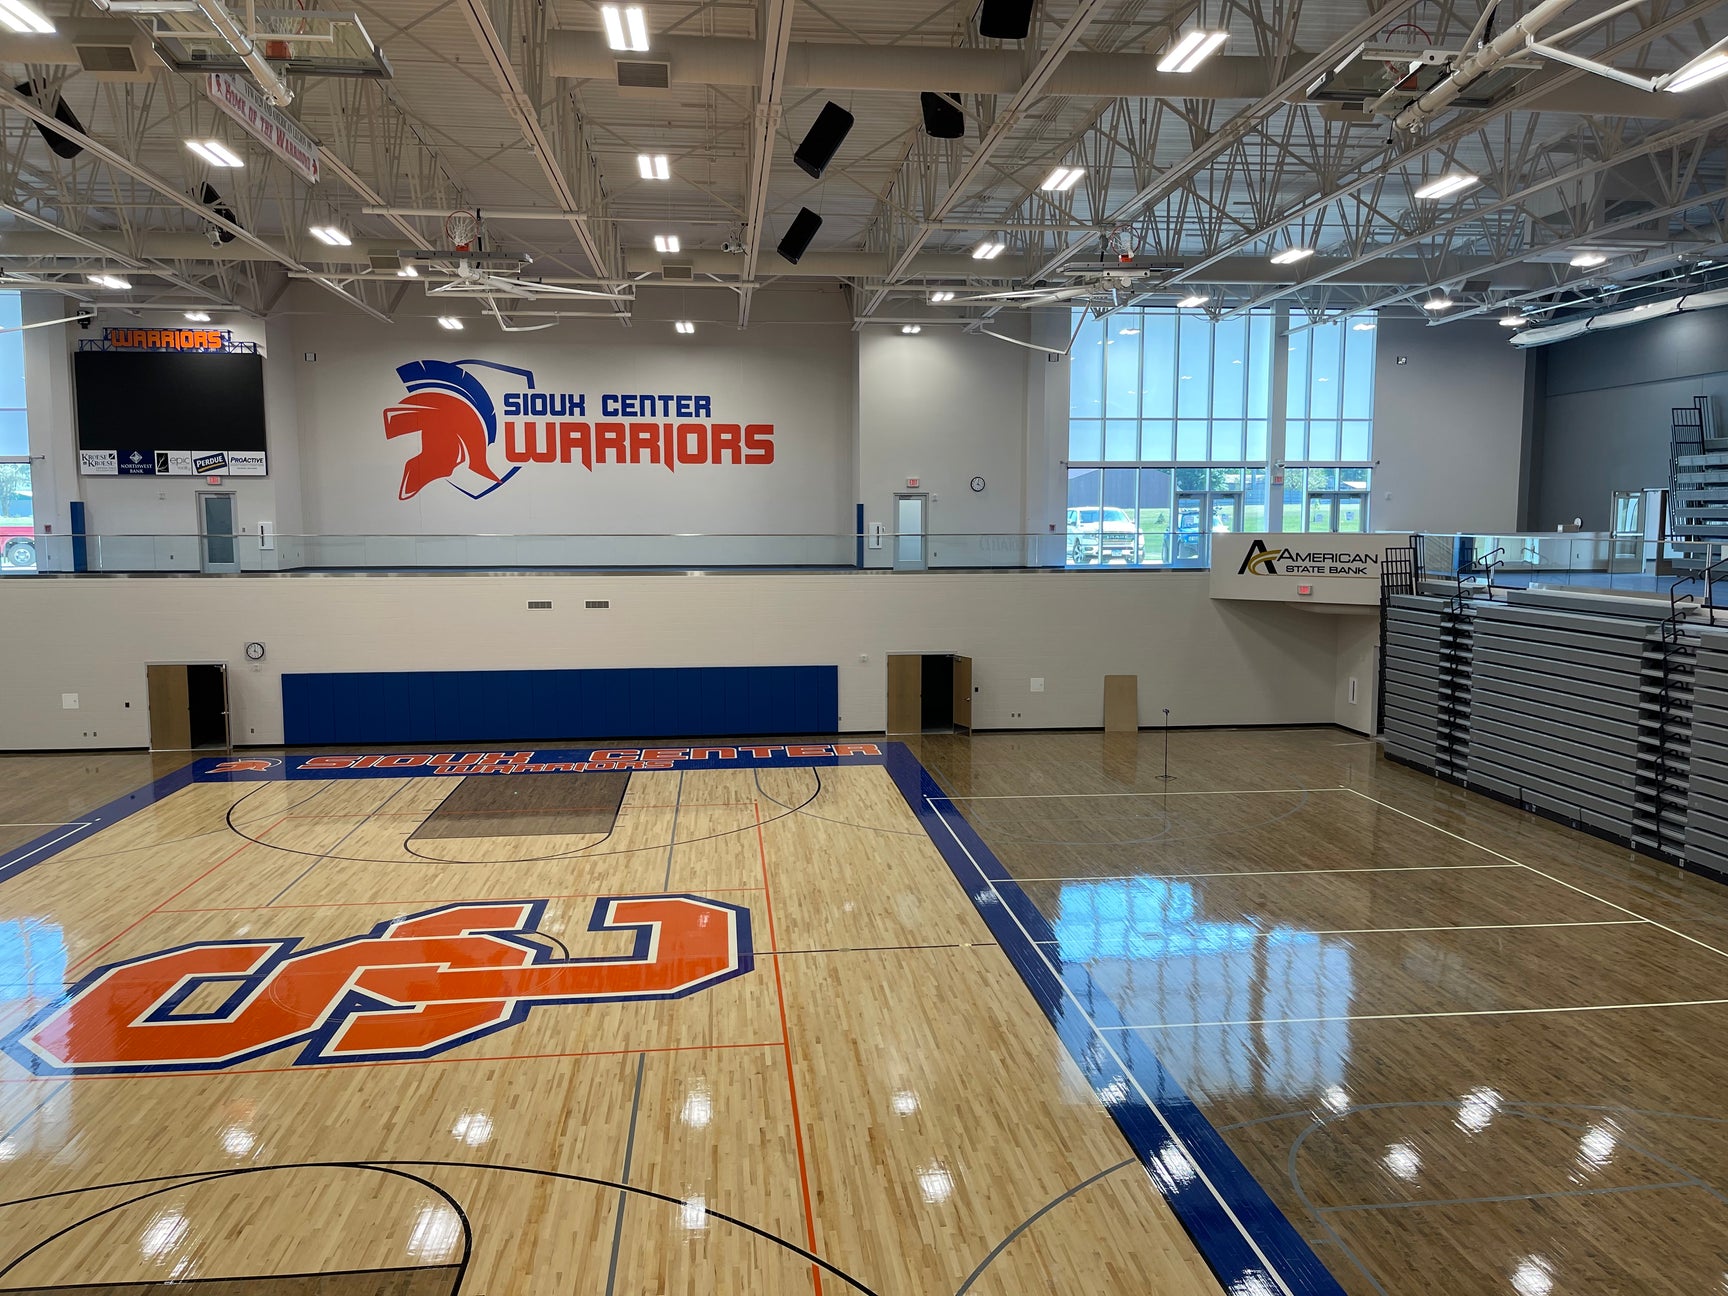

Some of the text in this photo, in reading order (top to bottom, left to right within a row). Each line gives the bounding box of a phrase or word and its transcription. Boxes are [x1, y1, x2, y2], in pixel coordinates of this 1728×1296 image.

[224, 80, 246, 117] HOME
[248, 106, 258, 126] OF
[260, 117, 274, 141] THE
[112, 330, 221, 349] WARRIORS
[503, 392, 712, 418] SIOUX CENTER
[504, 421, 775, 474] WARRIORS
[170, 457, 190, 468] epic
[196, 455, 223, 468] PERDUE
[1276, 548, 1378, 564] AMERICAN
[1286, 565, 1367, 575] STATE BANK
[297, 743, 882, 769] SIOUX CENTER
[433, 760, 674, 775] WARRIORS
